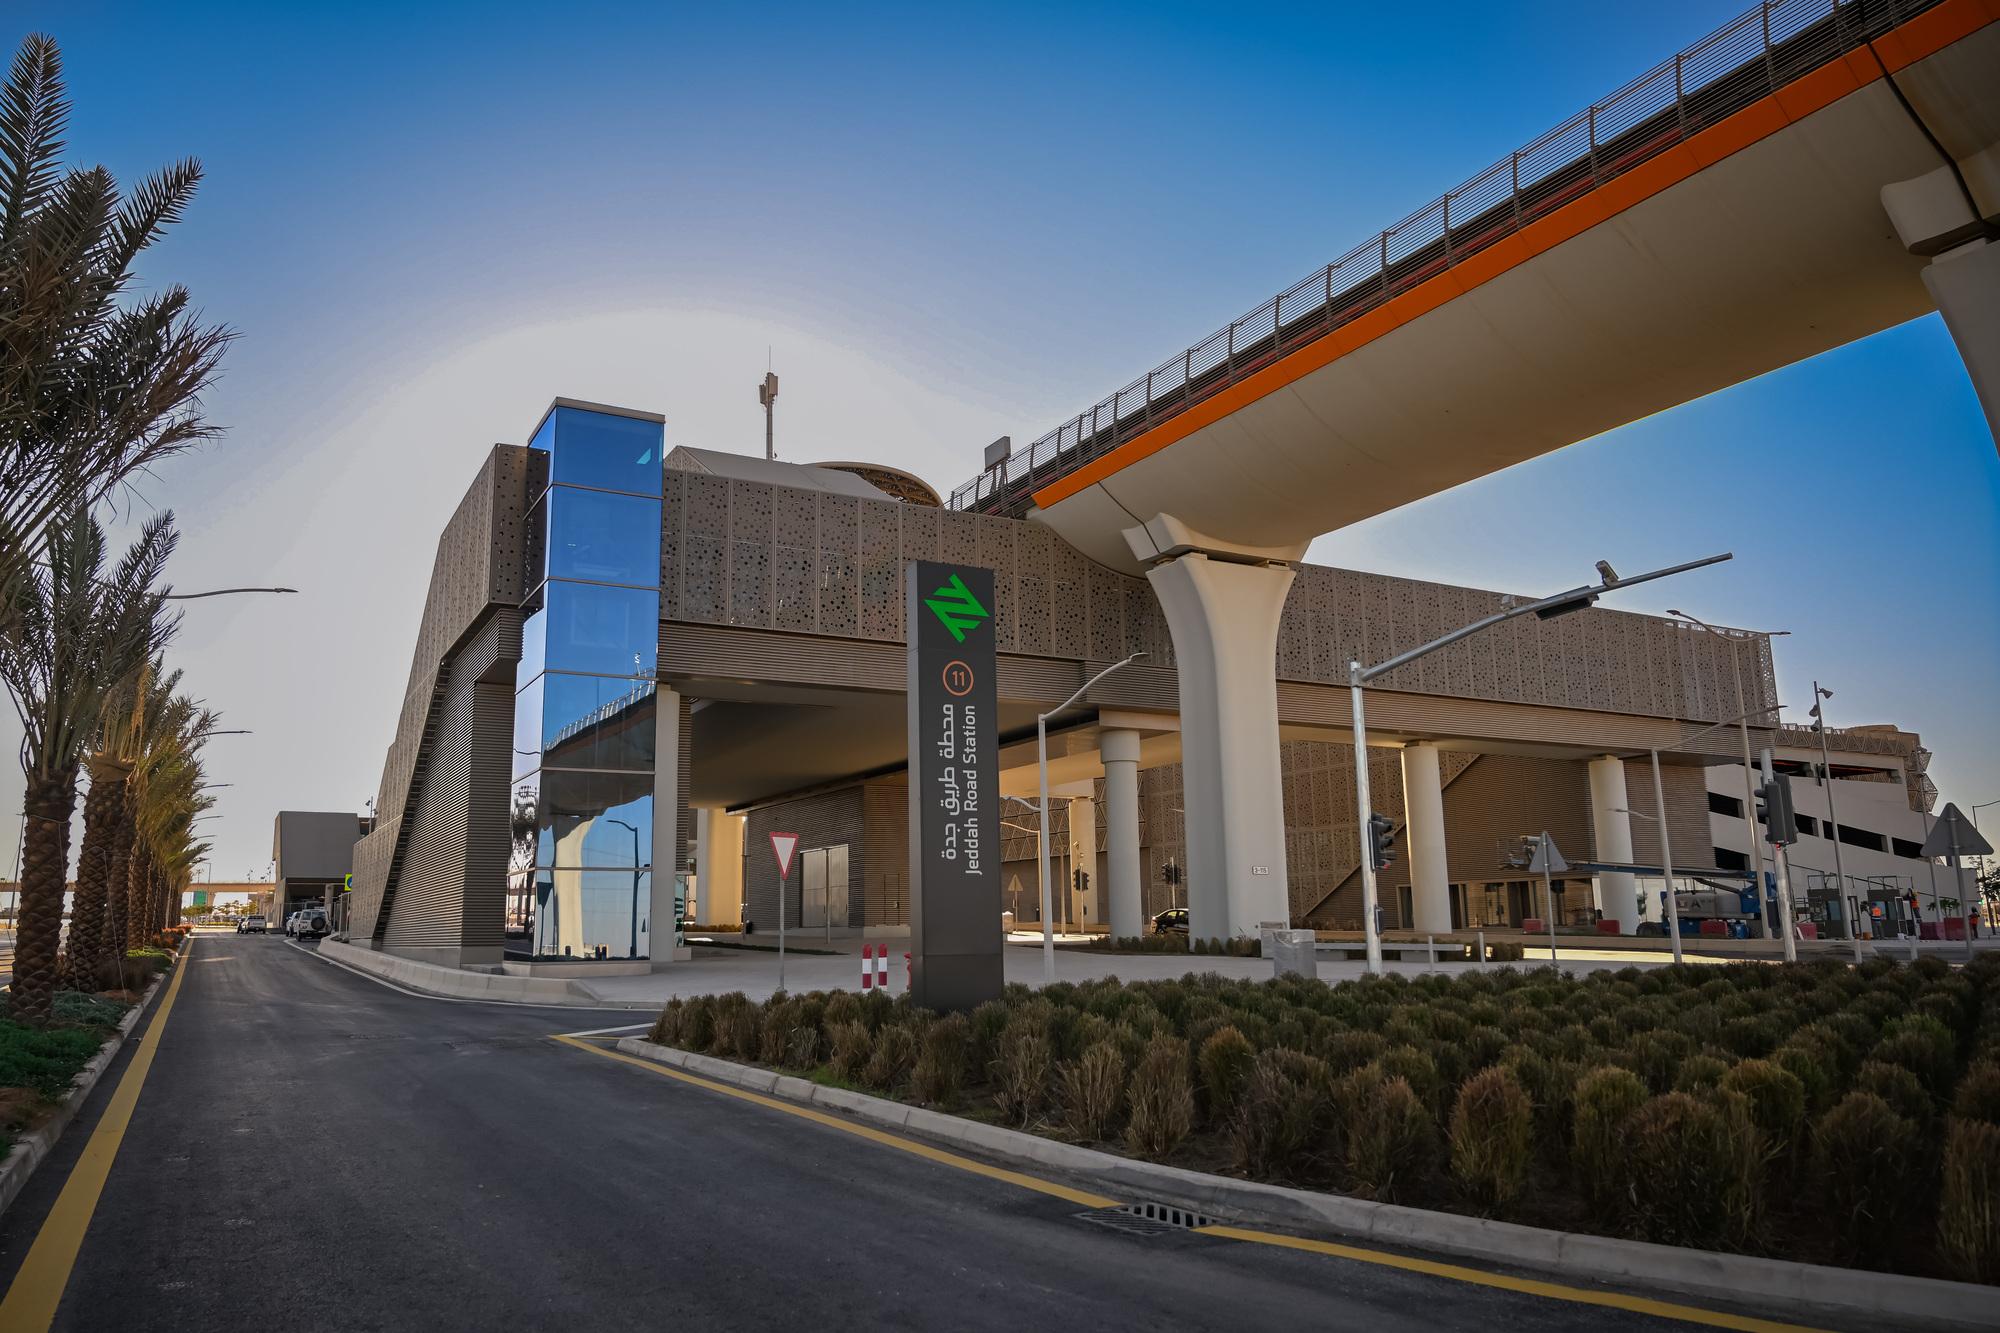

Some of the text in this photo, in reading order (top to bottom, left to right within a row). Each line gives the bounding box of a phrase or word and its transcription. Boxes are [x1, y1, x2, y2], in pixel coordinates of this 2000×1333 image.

[952, 670, 965, 687] 11
[937, 703, 961, 860] محطة طريق جدة
[962, 704, 983, 876] Jeddah Road Station
